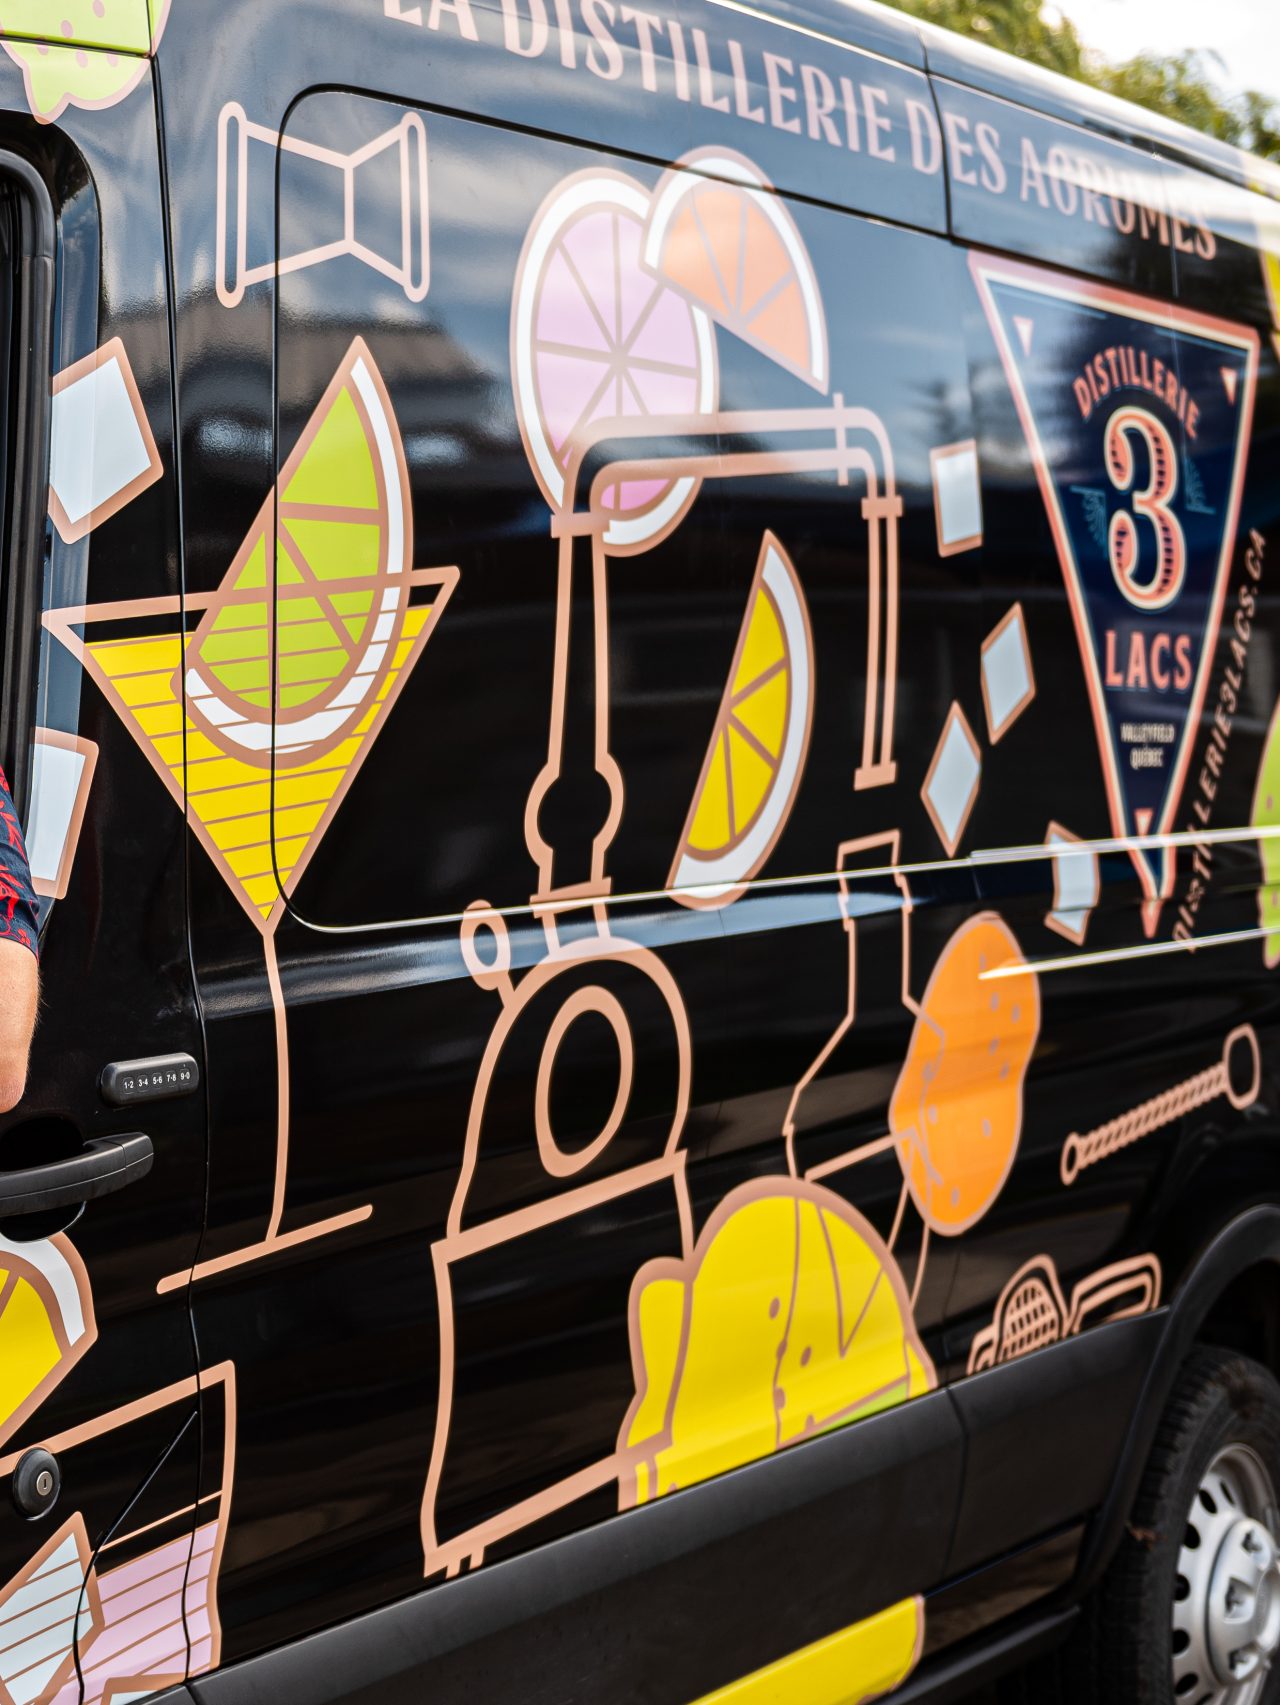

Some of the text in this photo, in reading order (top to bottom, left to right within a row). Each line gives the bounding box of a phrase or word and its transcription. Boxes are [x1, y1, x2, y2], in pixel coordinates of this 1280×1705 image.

[500, 0, 896, 163] DISTILLERIE
[904, 98, 1007, 194] DES
[1073, 345, 1199, 439] DISTILLERIE
[1104, 406, 1186, 611] 3
[1105, 630, 1192, 690] LACS
